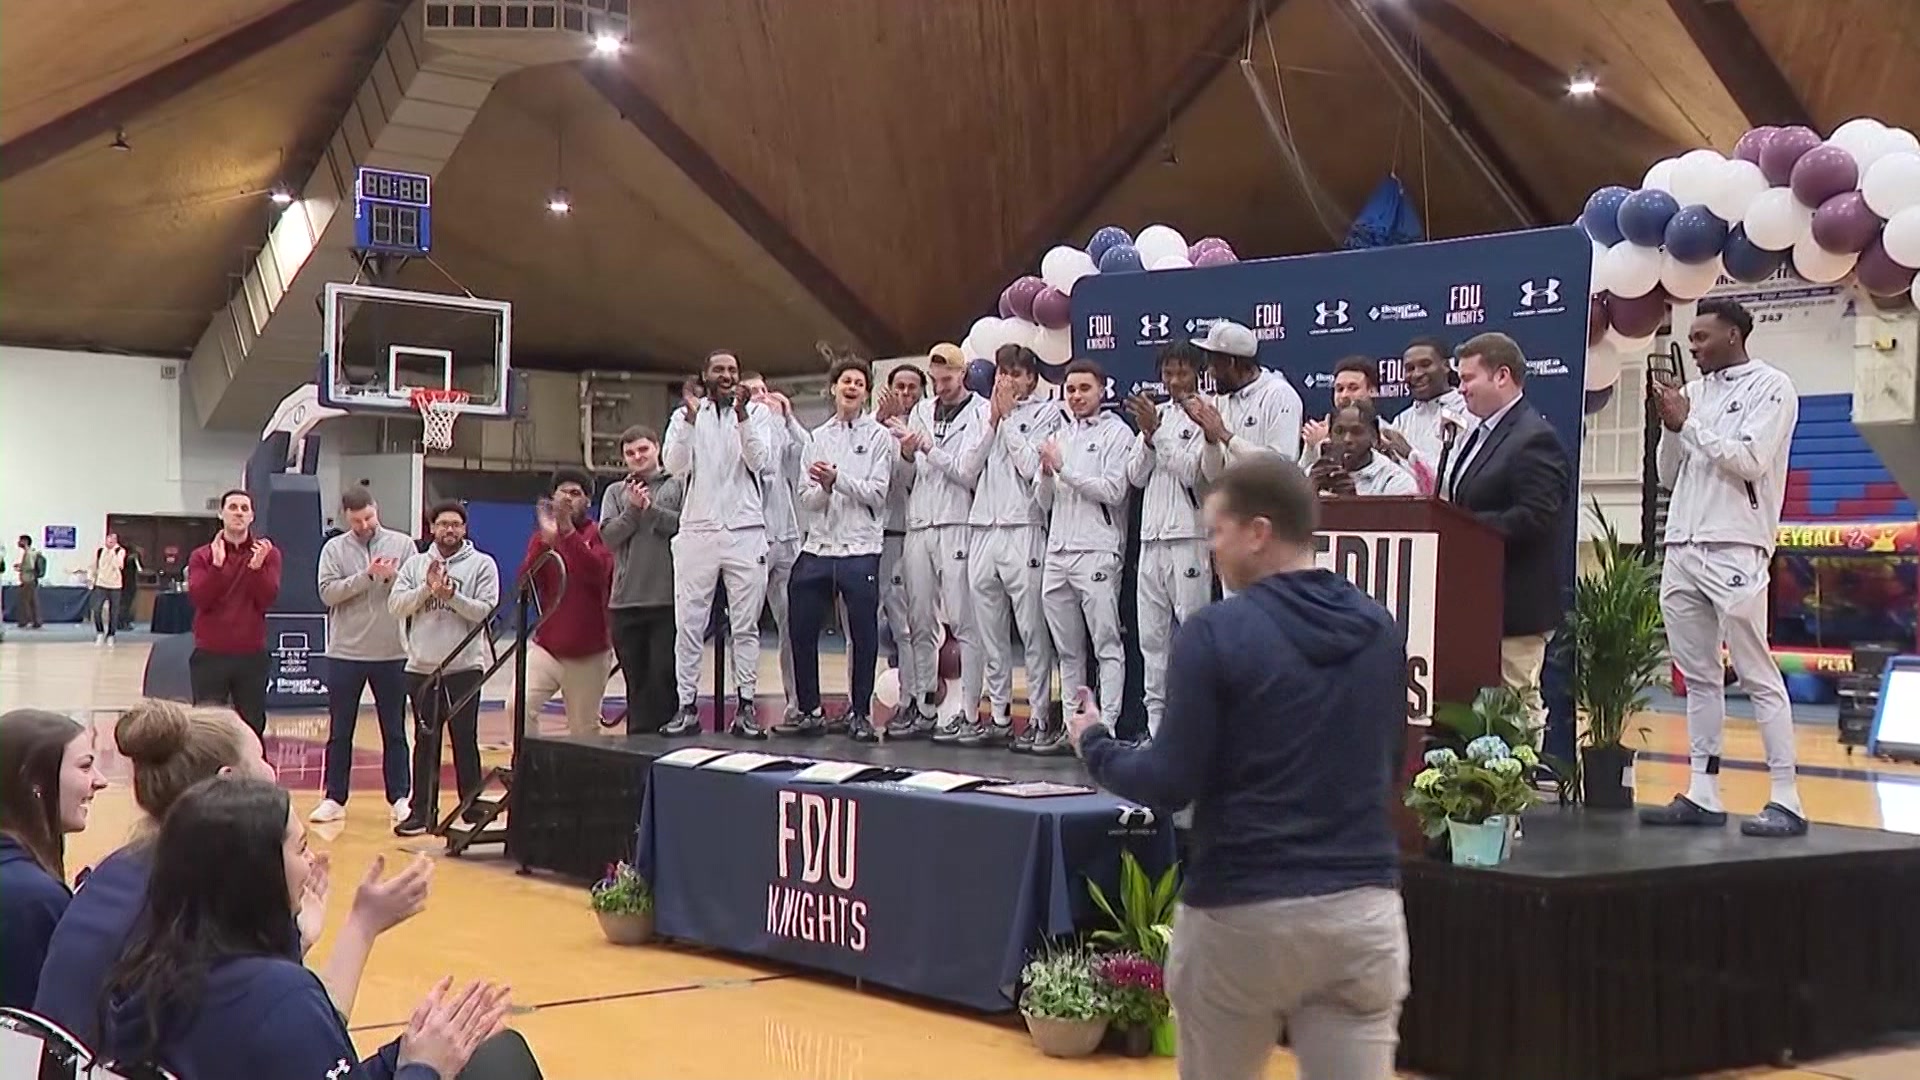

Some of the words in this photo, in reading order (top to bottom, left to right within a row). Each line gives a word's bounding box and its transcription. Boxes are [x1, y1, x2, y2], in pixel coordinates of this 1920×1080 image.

[1450, 285, 1481, 310] FDU
[1089, 315, 1112, 337] FDU
[1256, 303, 1281, 326] FDU
[1446, 310, 1484, 325] KNIGHTS
[1086, 337, 1115, 349] KNIGHTS
[1253, 327, 1286, 341] NIGHTS
[1379, 359, 1406, 383] FDU
[1775, 529, 1844, 547] EYBALL
[1313, 535, 1413, 640] DU
[779, 789, 857, 890] FDU
[767, 884, 867, 951] KNIGHTS
